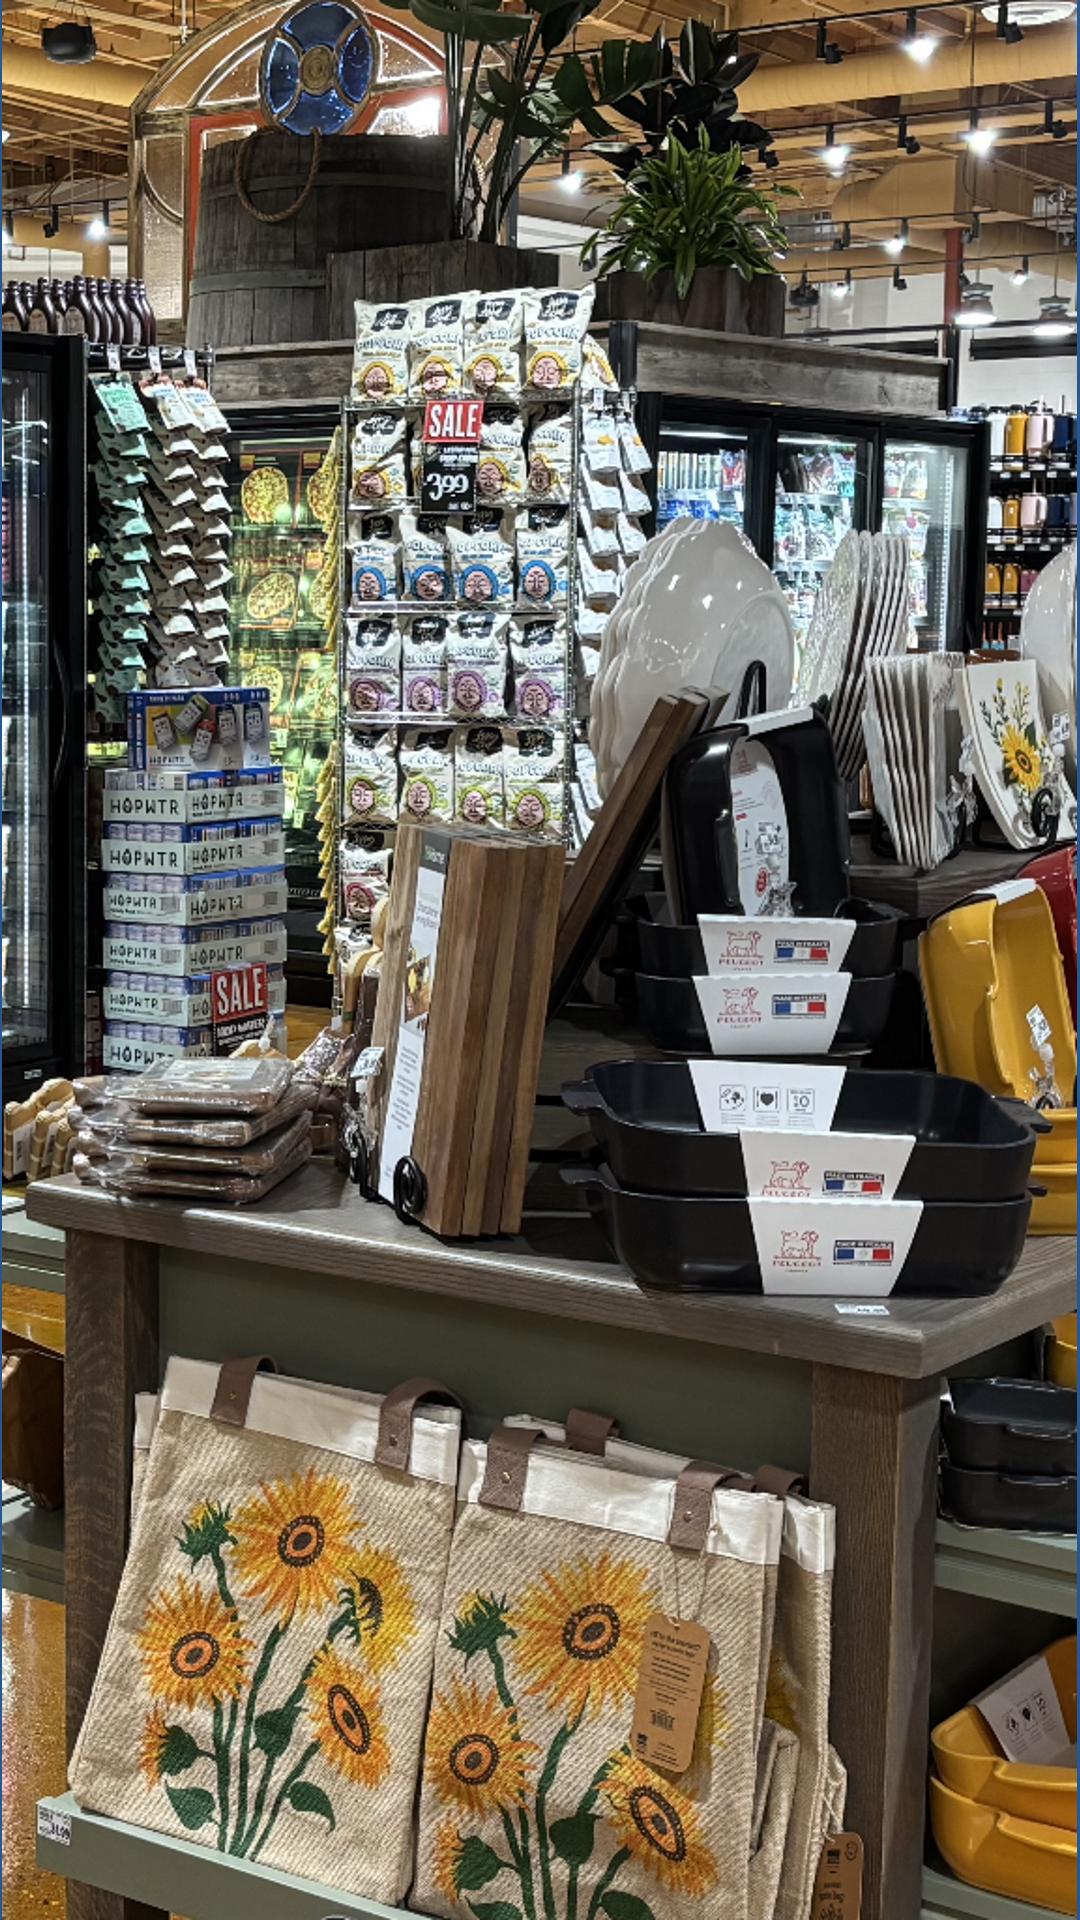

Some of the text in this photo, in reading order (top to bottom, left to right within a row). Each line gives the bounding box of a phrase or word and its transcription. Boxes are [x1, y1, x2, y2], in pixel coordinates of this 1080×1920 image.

[429, 404, 477, 437] SALE
[110, 798, 179, 815] HOPWTR
[192, 792, 244, 810] HOPWTR
[110, 850, 177, 867] HOPWTR
[192, 844, 244, 863] HOPWTR
[109, 894, 157, 910] HOPWTR
[190, 895, 244, 916] HOPWTR
[110, 945, 157, 960] HOPWTR
[190, 946, 243, 966] HOPWTR
[719, 958, 763, 966] PEUGEOT
[216, 968, 265, 1016] SALE
[110, 994, 159, 1010] HOPWTR
[110, 1046, 175, 1064] HOPW
